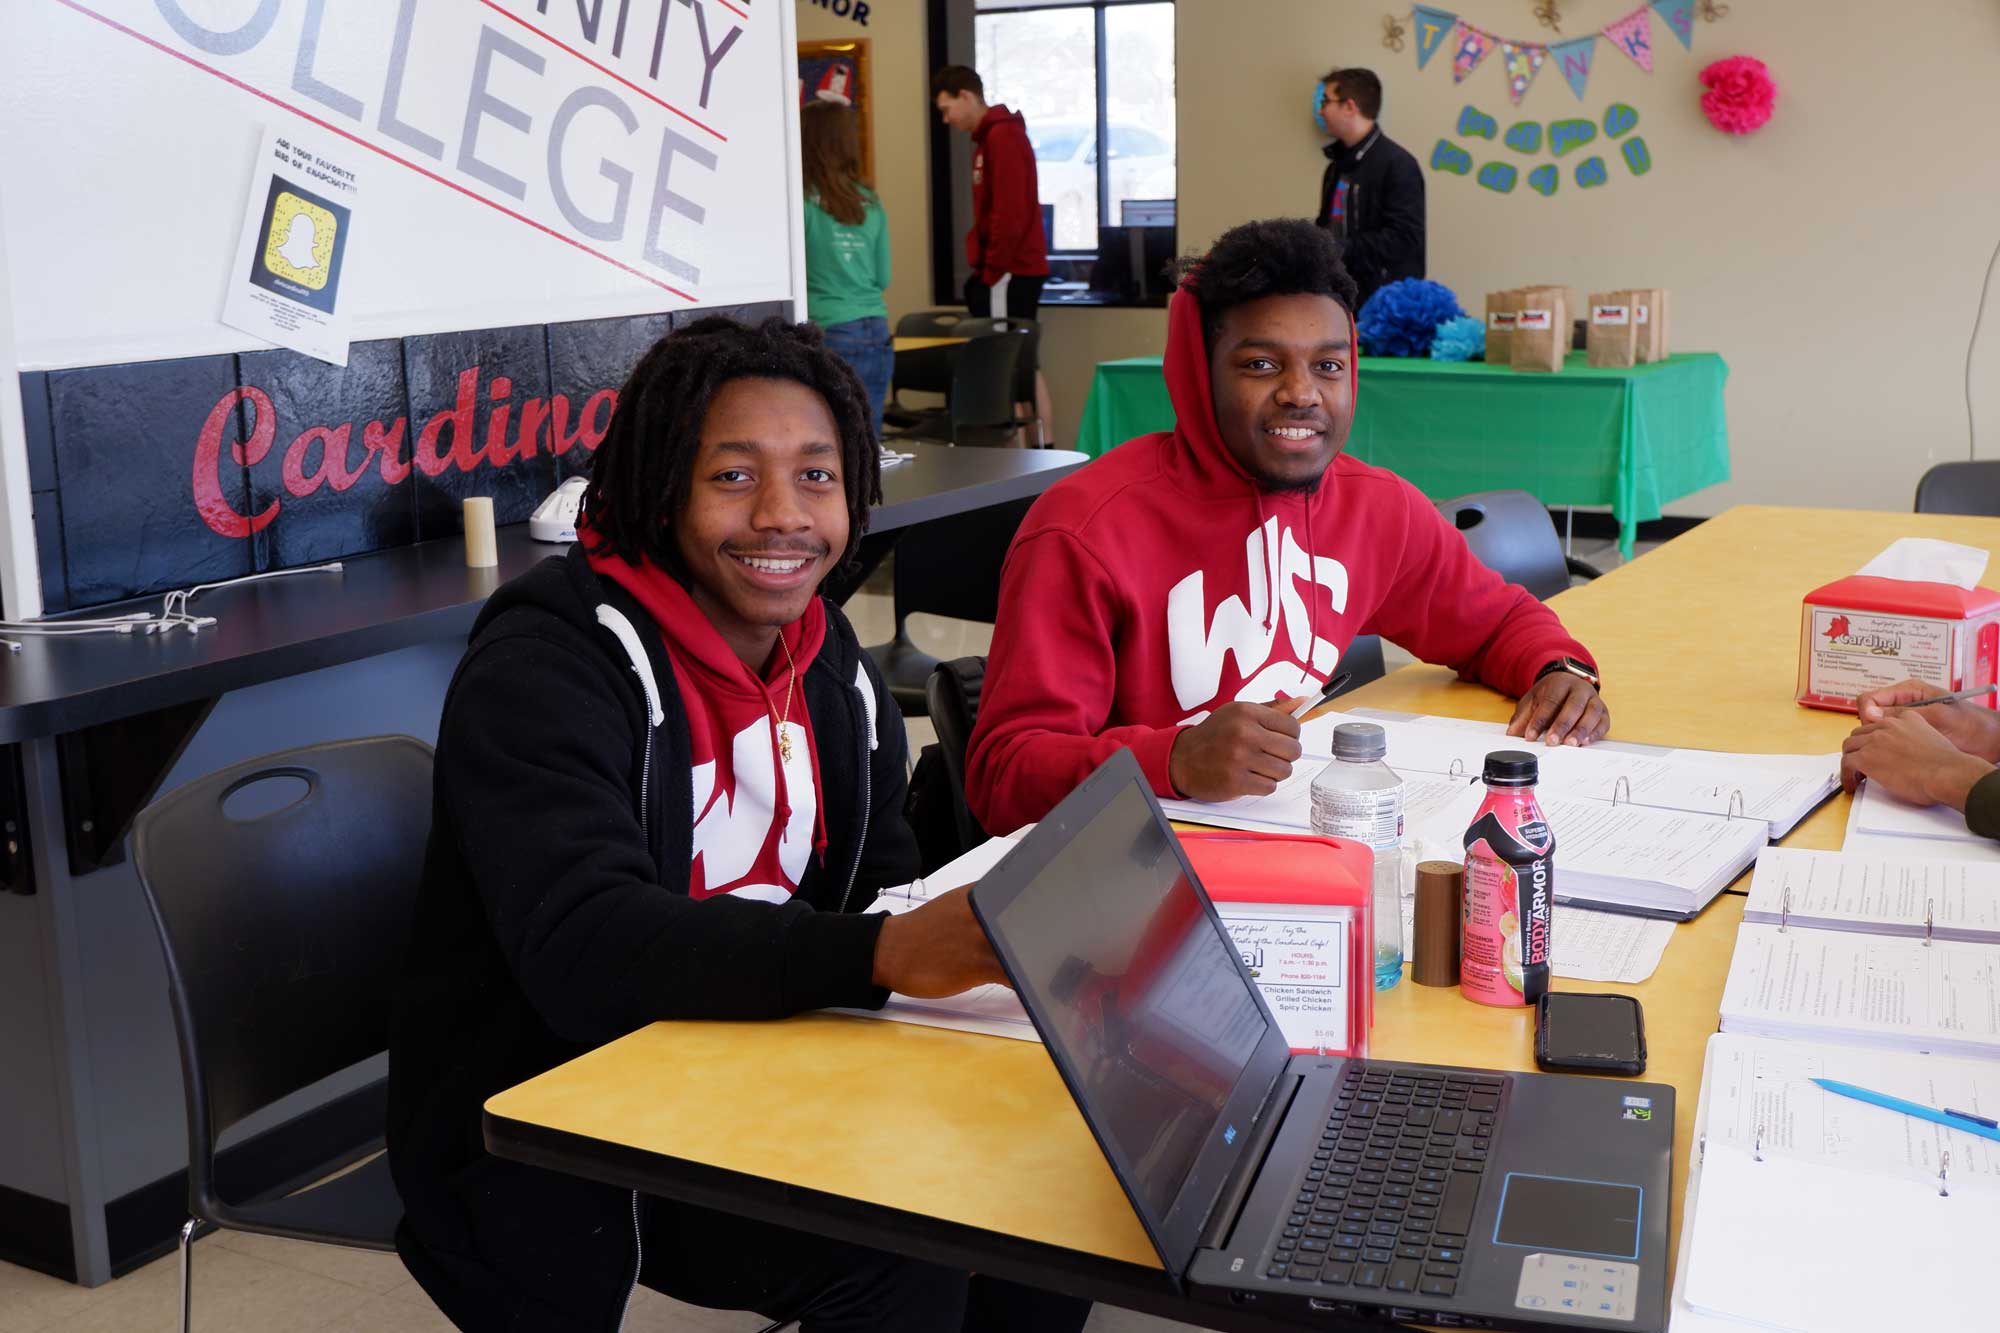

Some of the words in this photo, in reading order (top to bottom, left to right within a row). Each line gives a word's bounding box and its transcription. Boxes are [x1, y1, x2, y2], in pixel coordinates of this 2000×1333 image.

[315, 157, 356, 182] FAVORITE
[1531, 857, 1547, 965] BODYARMOR
[1264, 986, 1294, 994] Chicken
[1296, 987, 1332, 995] Sandwich
[1279, 1004, 1300, 1012] Spicy
[1302, 1004, 1332, 1012] Chicken
